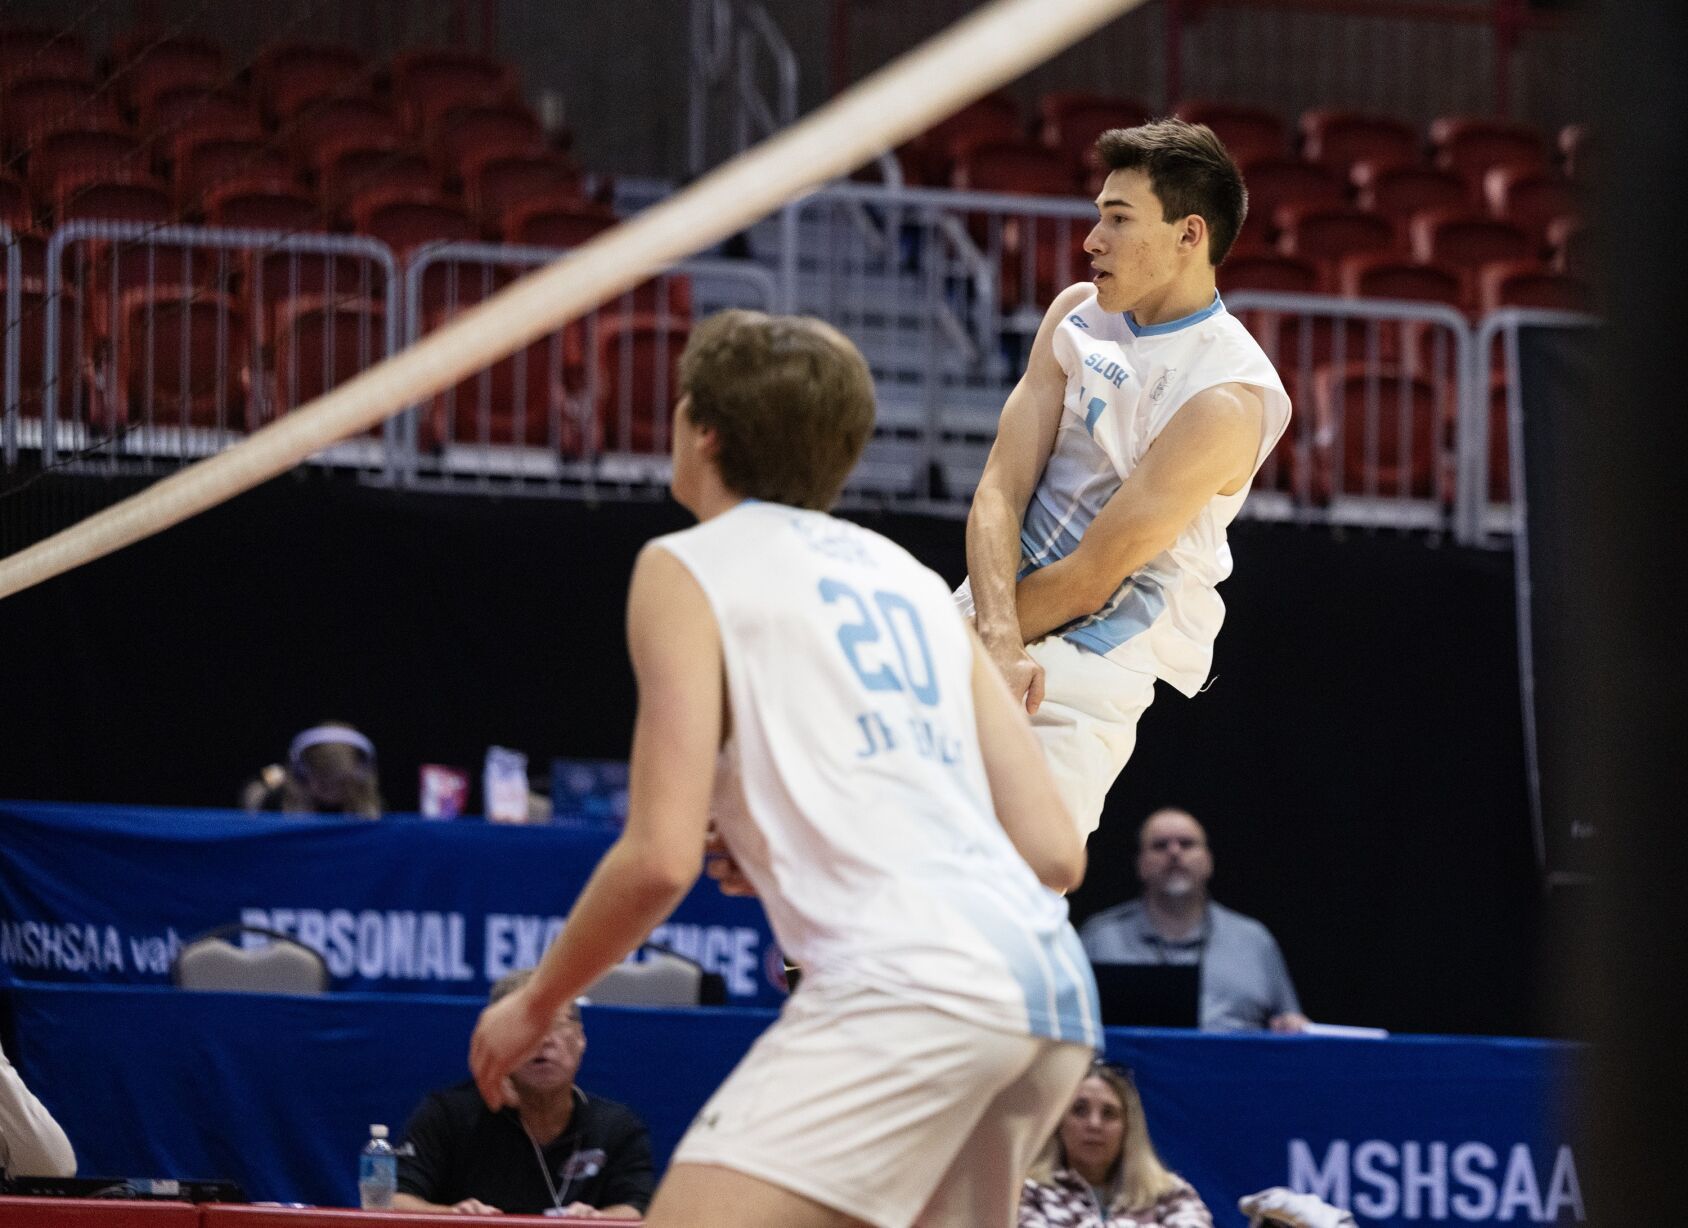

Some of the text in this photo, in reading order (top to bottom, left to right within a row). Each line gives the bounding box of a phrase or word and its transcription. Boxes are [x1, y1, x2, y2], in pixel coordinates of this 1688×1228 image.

[817, 576, 941, 707] 20
[0, 920, 124, 973] MSHSAA
[1287, 1137, 1587, 1222] MSHSAA
